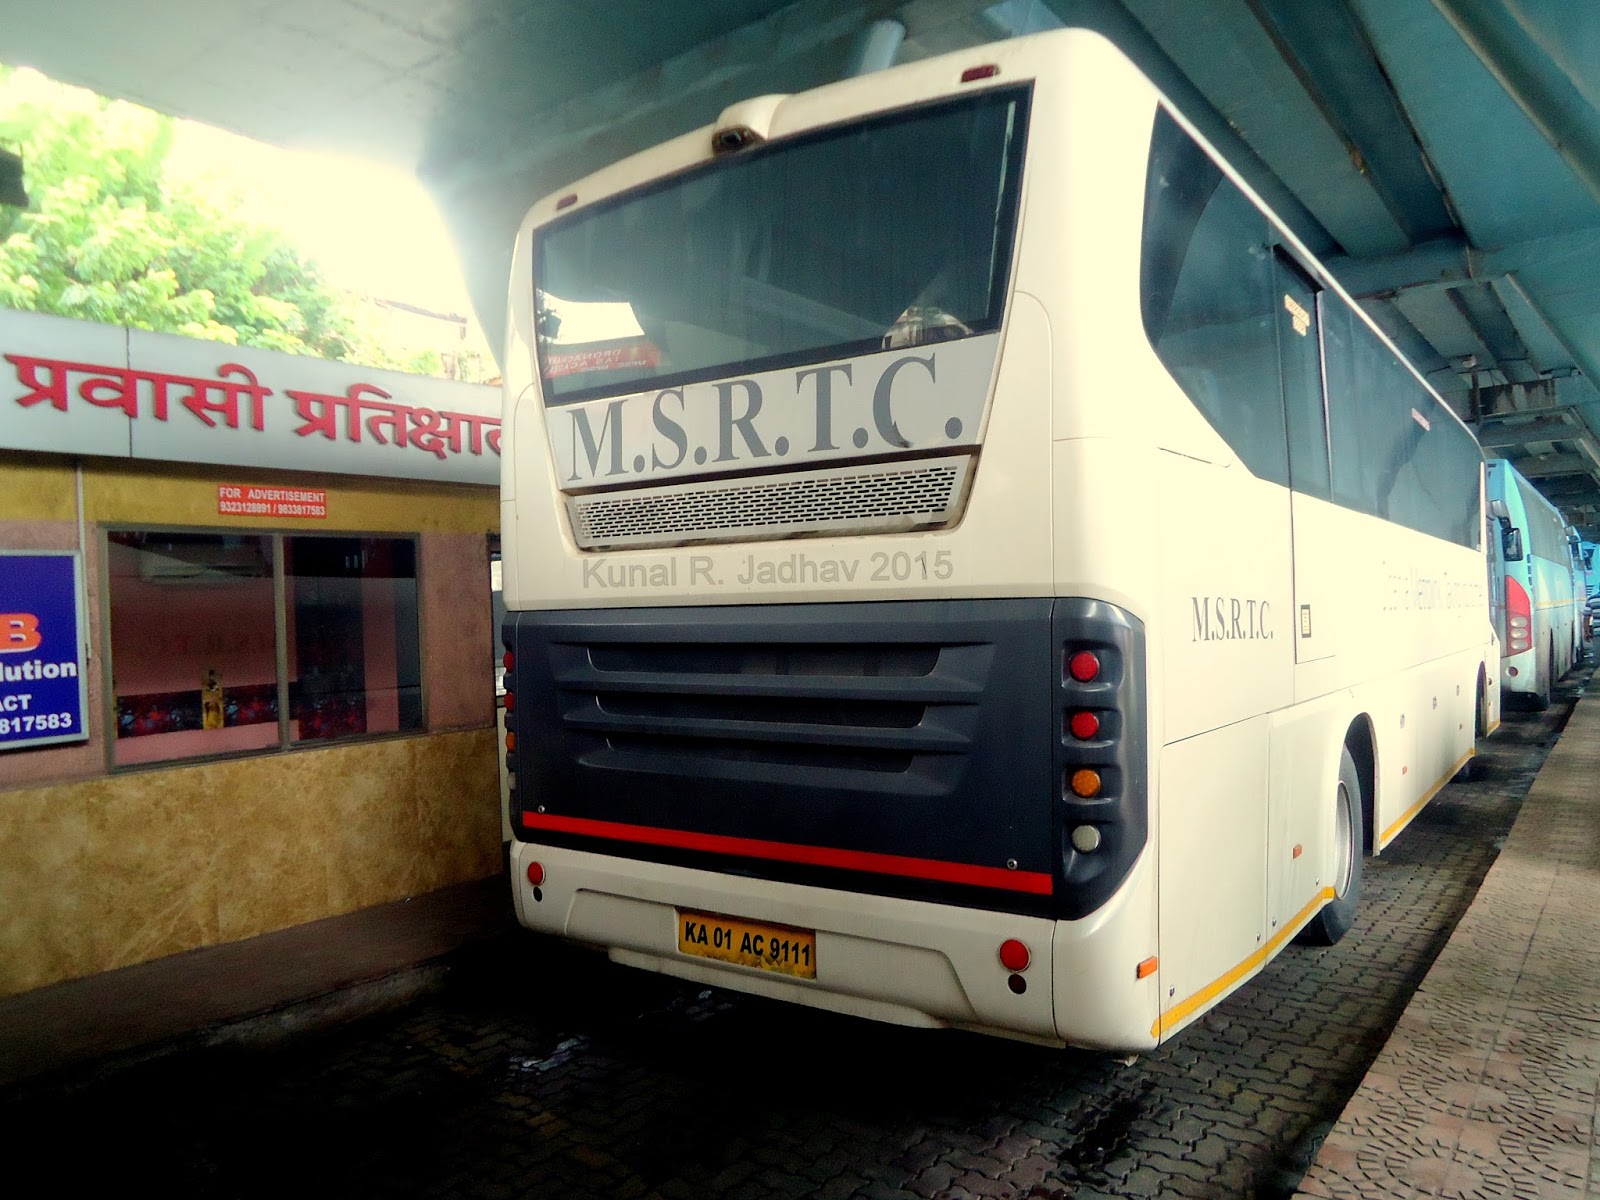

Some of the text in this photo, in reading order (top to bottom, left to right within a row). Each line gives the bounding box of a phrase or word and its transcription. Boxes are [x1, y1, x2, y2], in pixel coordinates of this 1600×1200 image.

[4, 354, 273, 431] प्रवासी
[566, 352, 963, 482] M.S.R.T.C.
[219, 487, 325, 503] FOR ADVERTISEMENT
[1190, 596, 1274, 642] M.S.R.T.C.
[685, 921, 810, 966] KA 01 AC 9111
